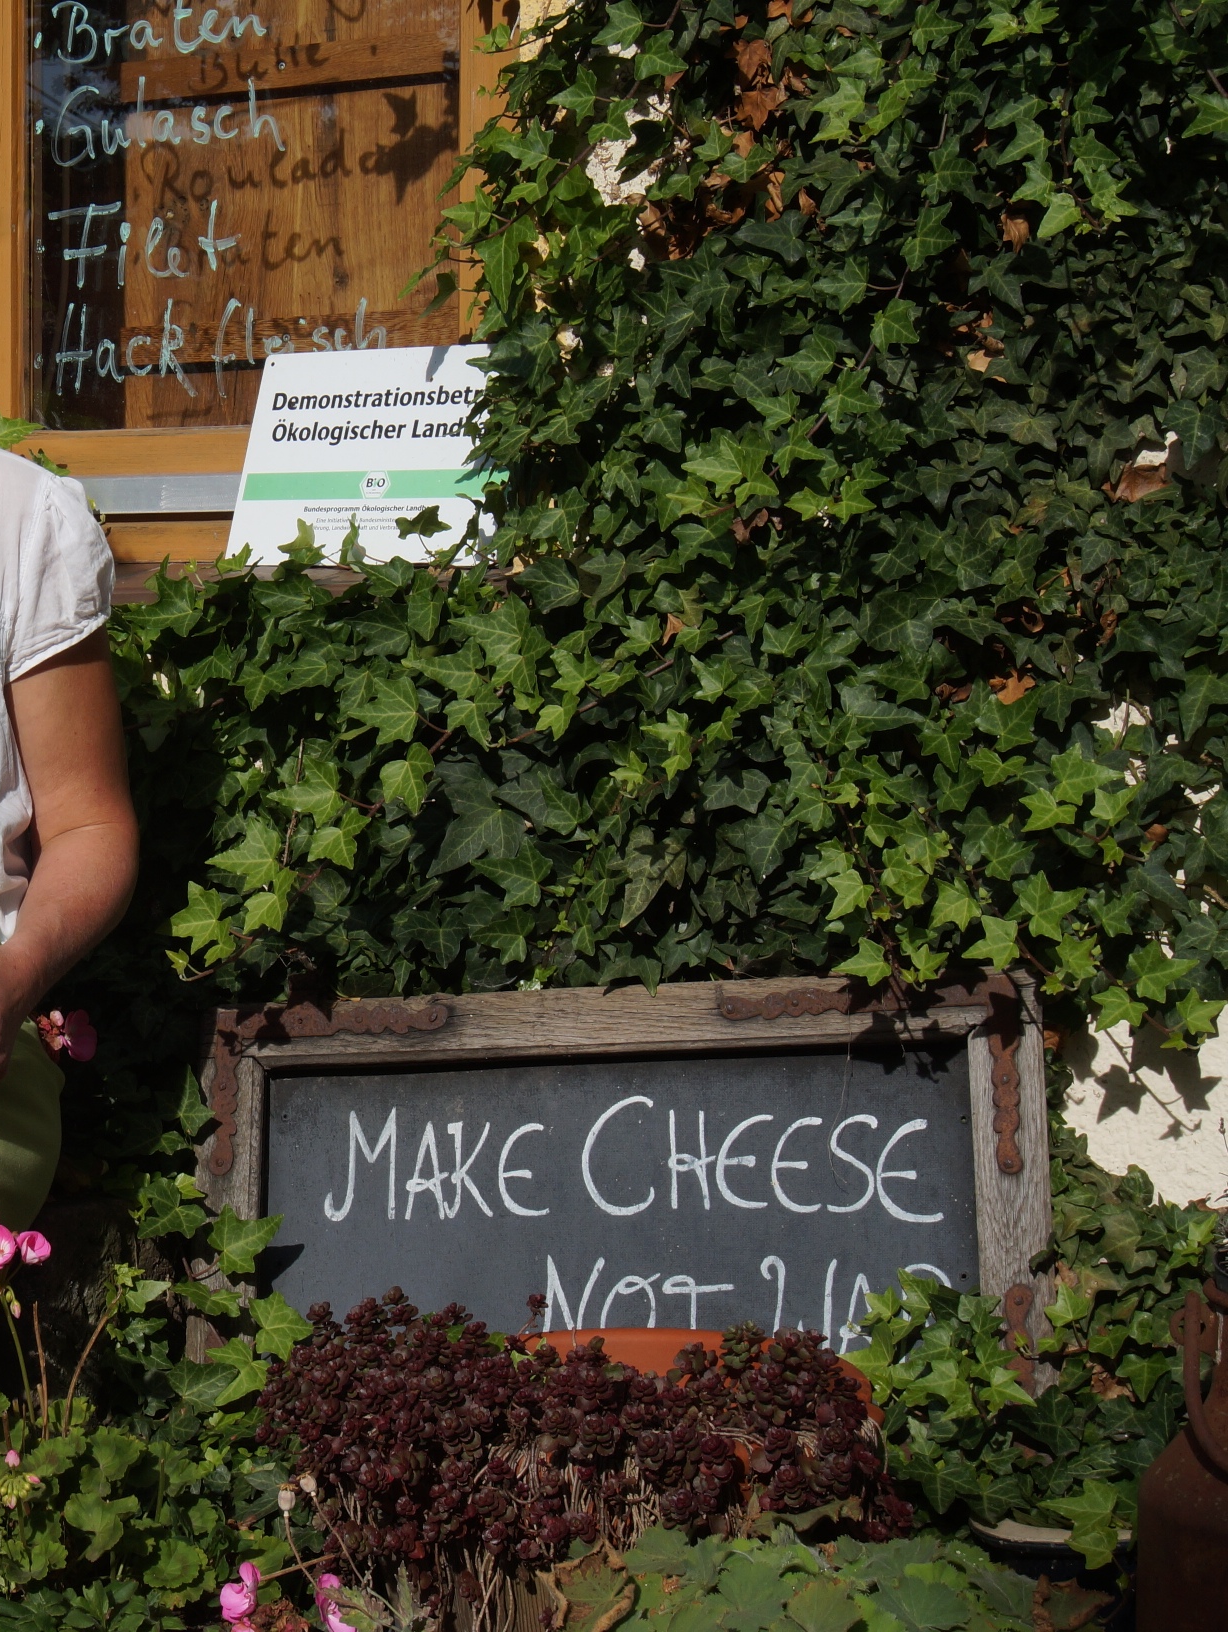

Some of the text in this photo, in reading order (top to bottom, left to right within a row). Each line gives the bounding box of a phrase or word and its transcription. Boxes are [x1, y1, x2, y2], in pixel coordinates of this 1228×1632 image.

[51, 0, 267, 65] Braten
[51, 76, 286, 167] Gulasch
[48, 199, 242, 289] Filet
[272, 418, 407, 446] Ökologischer
[303, 505, 360, 514] Bundesprogramm
[361, 503, 404, 513] Ökologischer
[325, 1095, 945, 1223] MAKE CHEESE
